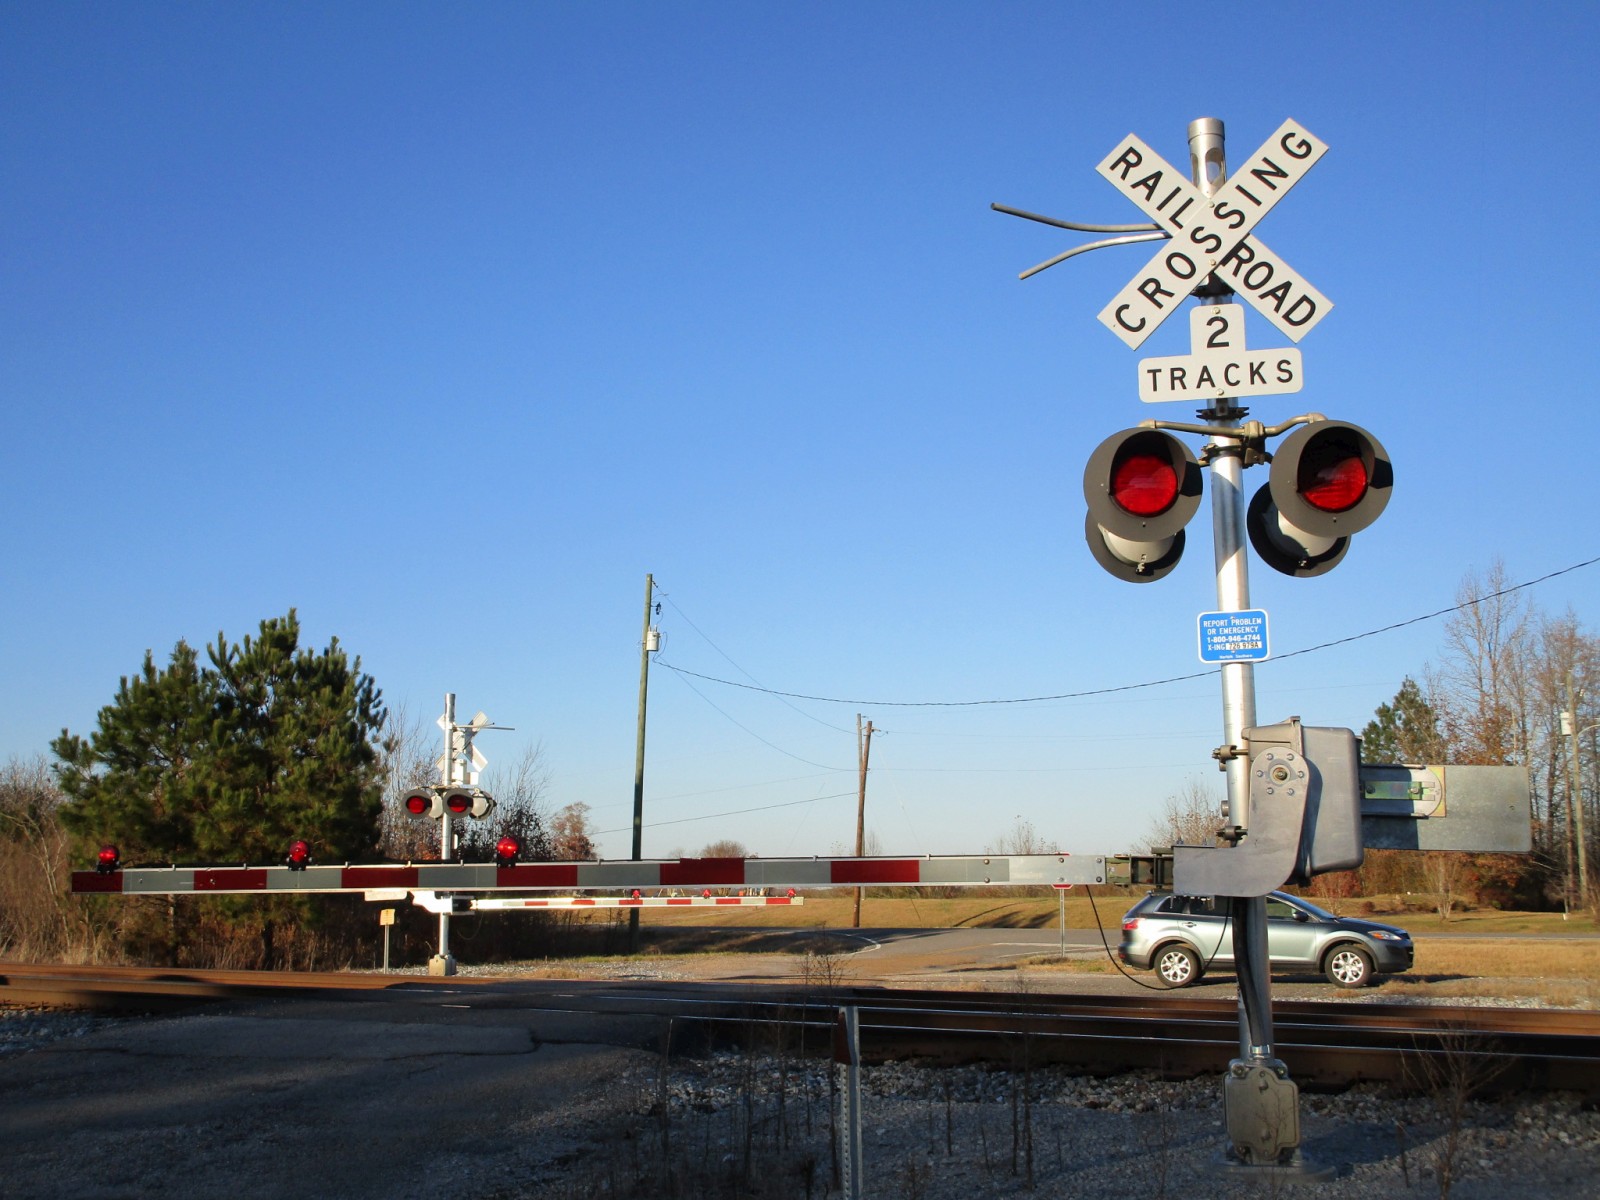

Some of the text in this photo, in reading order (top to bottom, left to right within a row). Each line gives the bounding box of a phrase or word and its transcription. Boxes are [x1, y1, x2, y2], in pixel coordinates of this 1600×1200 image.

[1109, 146, 1316, 327] RAIL ROAD
[1114, 132, 1312, 333] CROSSING
[1206, 316, 1230, 348] 2
[1147, 359, 1293, 392] TRACKS
[1220, 626, 1259, 634] EMERGENCY
[1231, 618, 1262, 626] PROBLEM
[1208, 643, 1226, 651] X-ING
